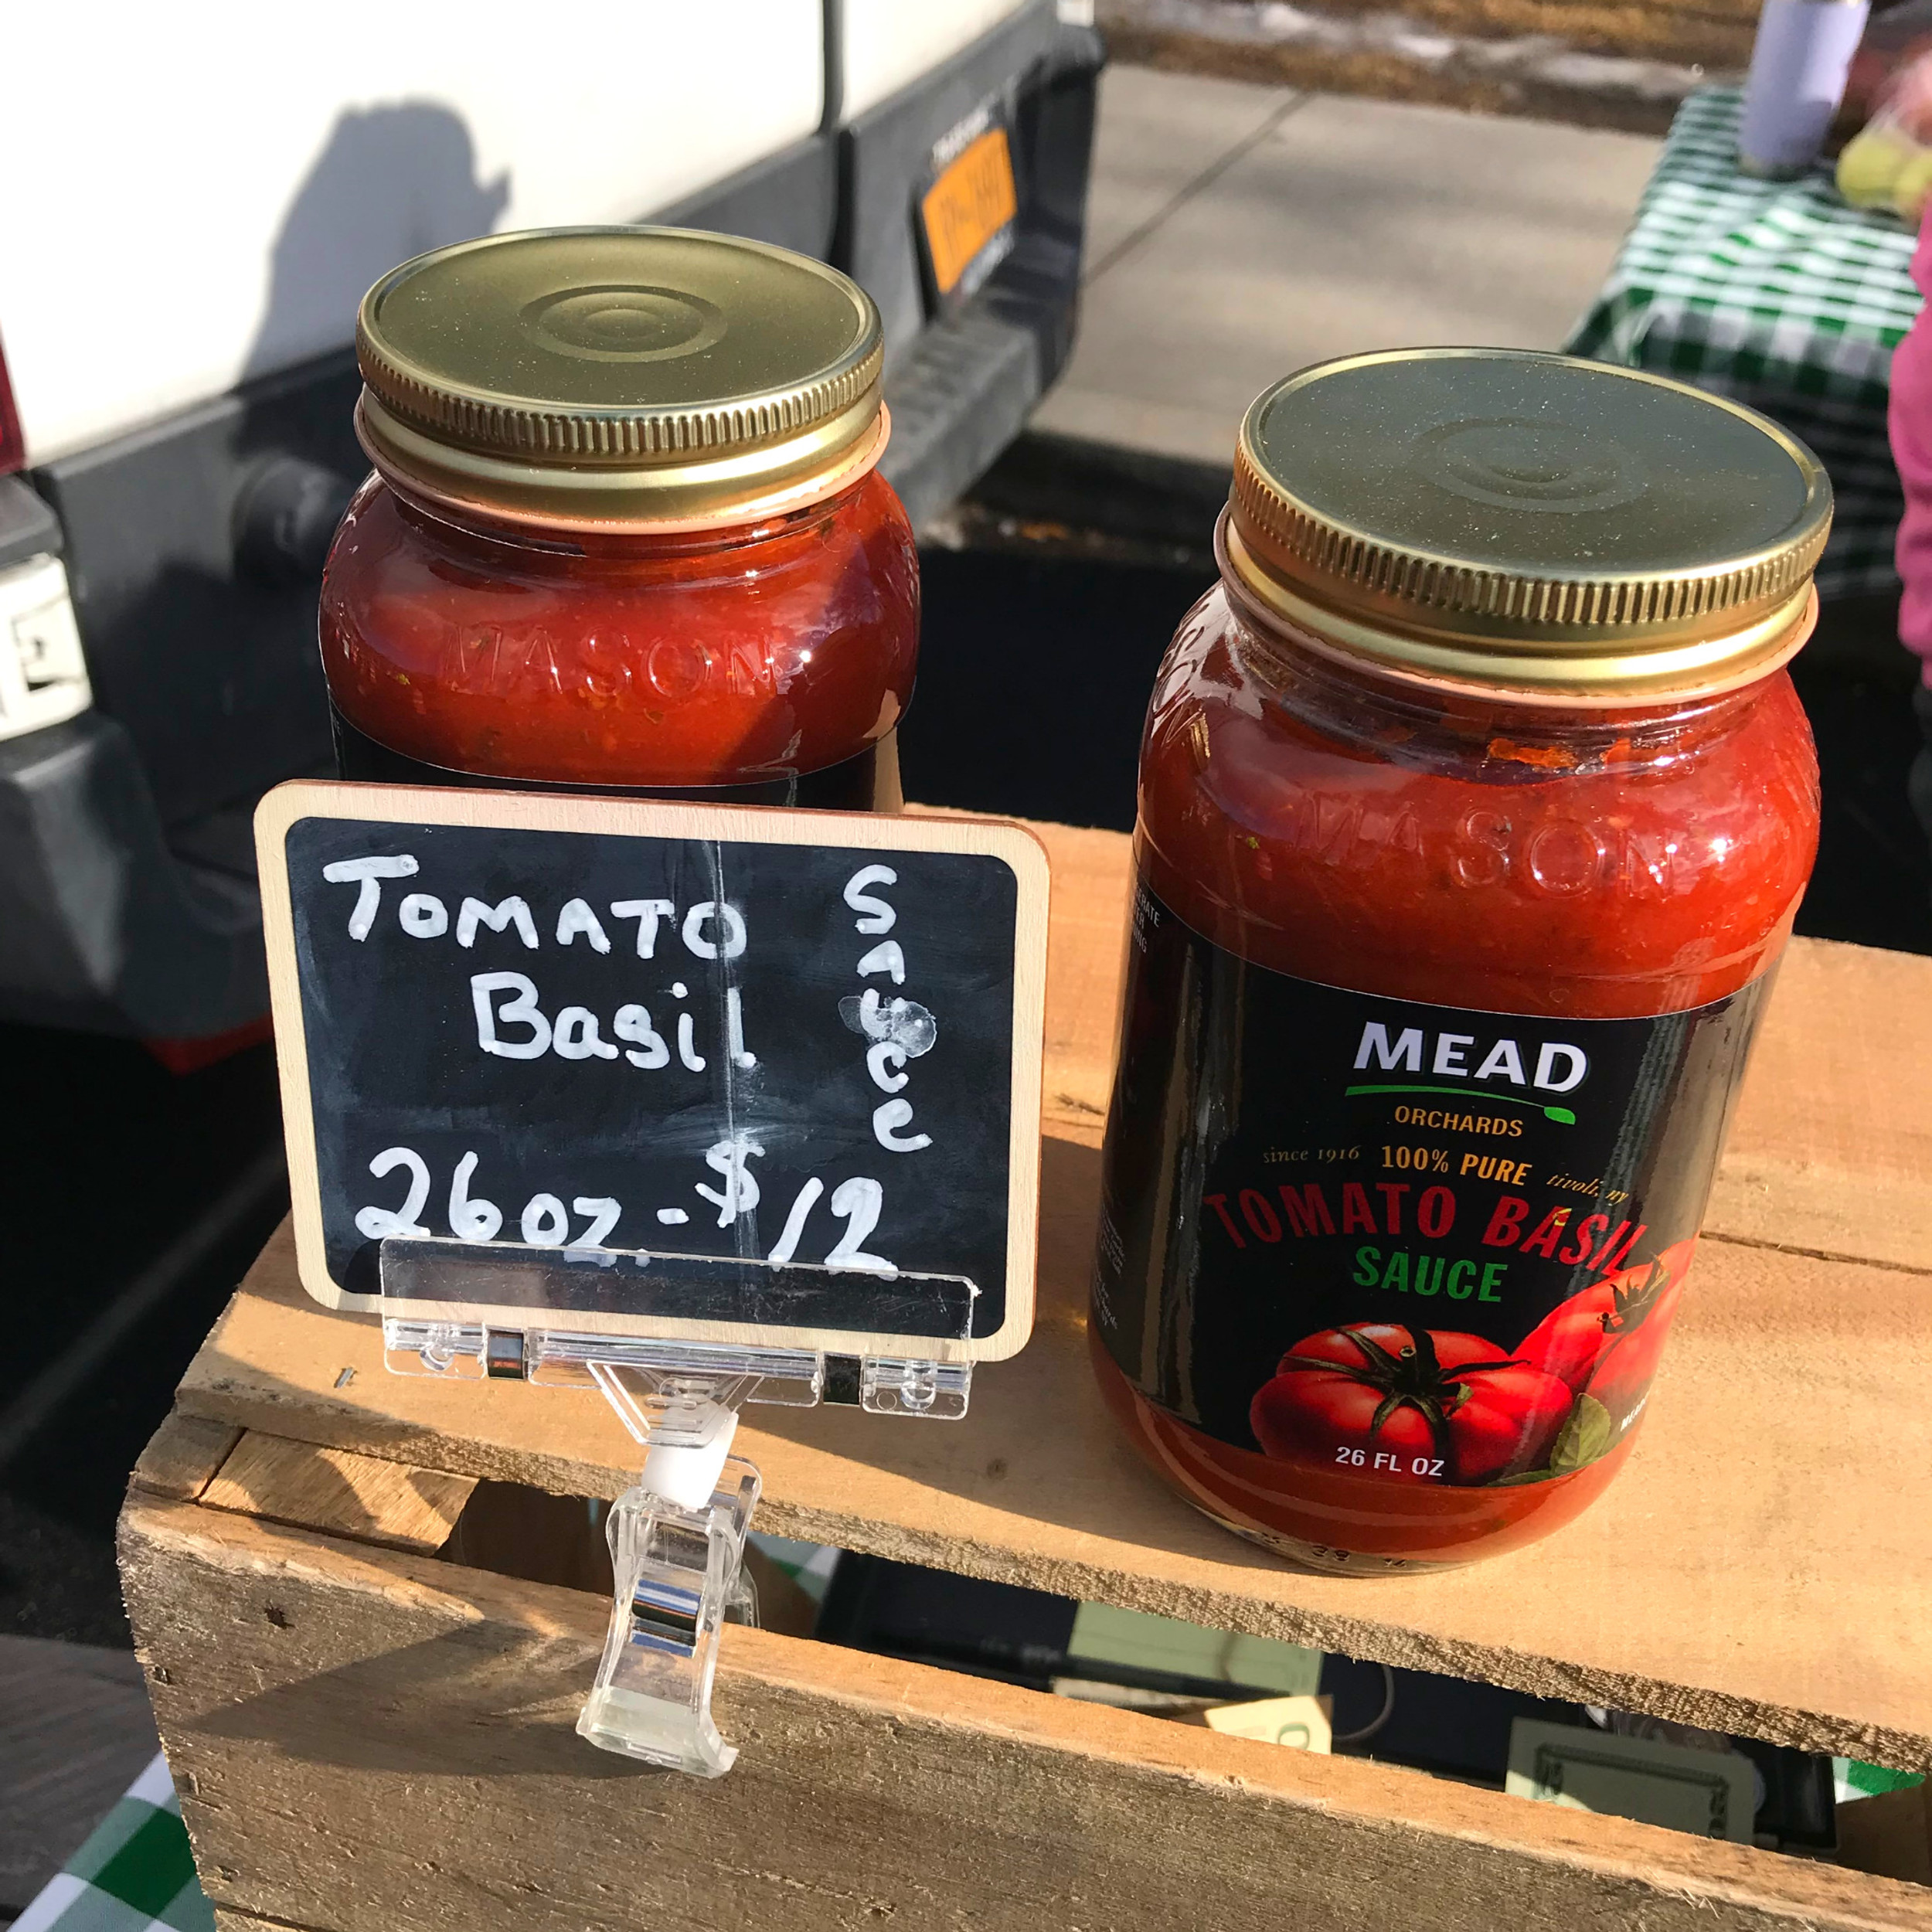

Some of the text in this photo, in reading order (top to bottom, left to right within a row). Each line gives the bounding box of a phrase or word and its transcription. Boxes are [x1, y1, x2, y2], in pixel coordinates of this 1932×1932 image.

[443, 624, 773, 697] MASON
[1292, 789, 1677, 903] MASON
[470, 971, 757, 1073] Basil
[1352, 1021, 1588, 1093] MEAD
[1394, 1105, 1524, 1138] ORCHARDS
[1262, 1145, 1362, 1165] since 1916
[1381, 1145, 1533, 1186] 100% PURE
[1546, 1172, 1630, 1206] tivoli, ny
[1203, 1182, 1458, 1249] TOMATO
[1480, 1195, 1649, 1279] BASIL
[1352, 1246, 1509, 1303] SAUCE
[1335, 1446, 1445, 1477] 26 FL OZ
